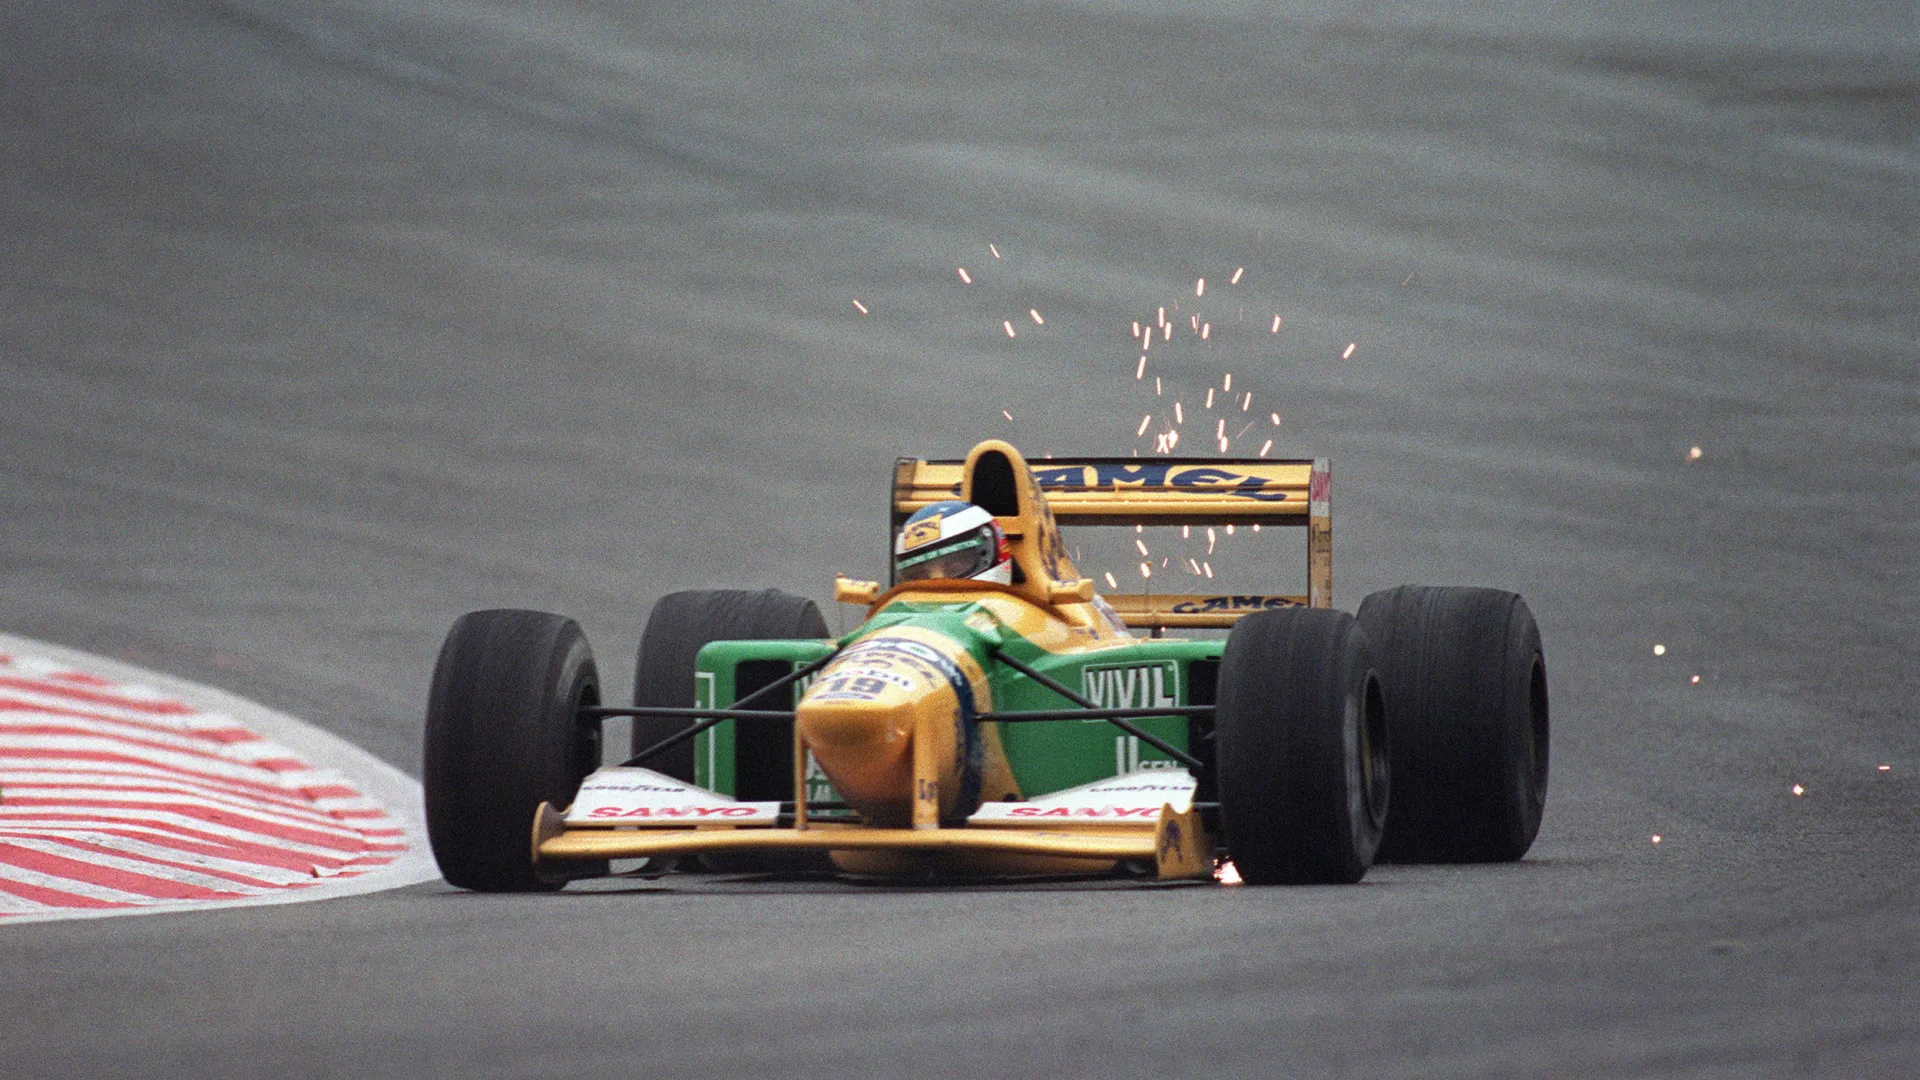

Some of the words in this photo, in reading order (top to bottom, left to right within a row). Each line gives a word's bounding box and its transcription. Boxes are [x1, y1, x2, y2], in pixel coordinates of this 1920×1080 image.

[952, 464, 1287, 502] AMEL
[830, 677, 887, 694] 19
[1086, 666, 1175, 709] VIVIL
[587, 805, 758, 818] SANYO
